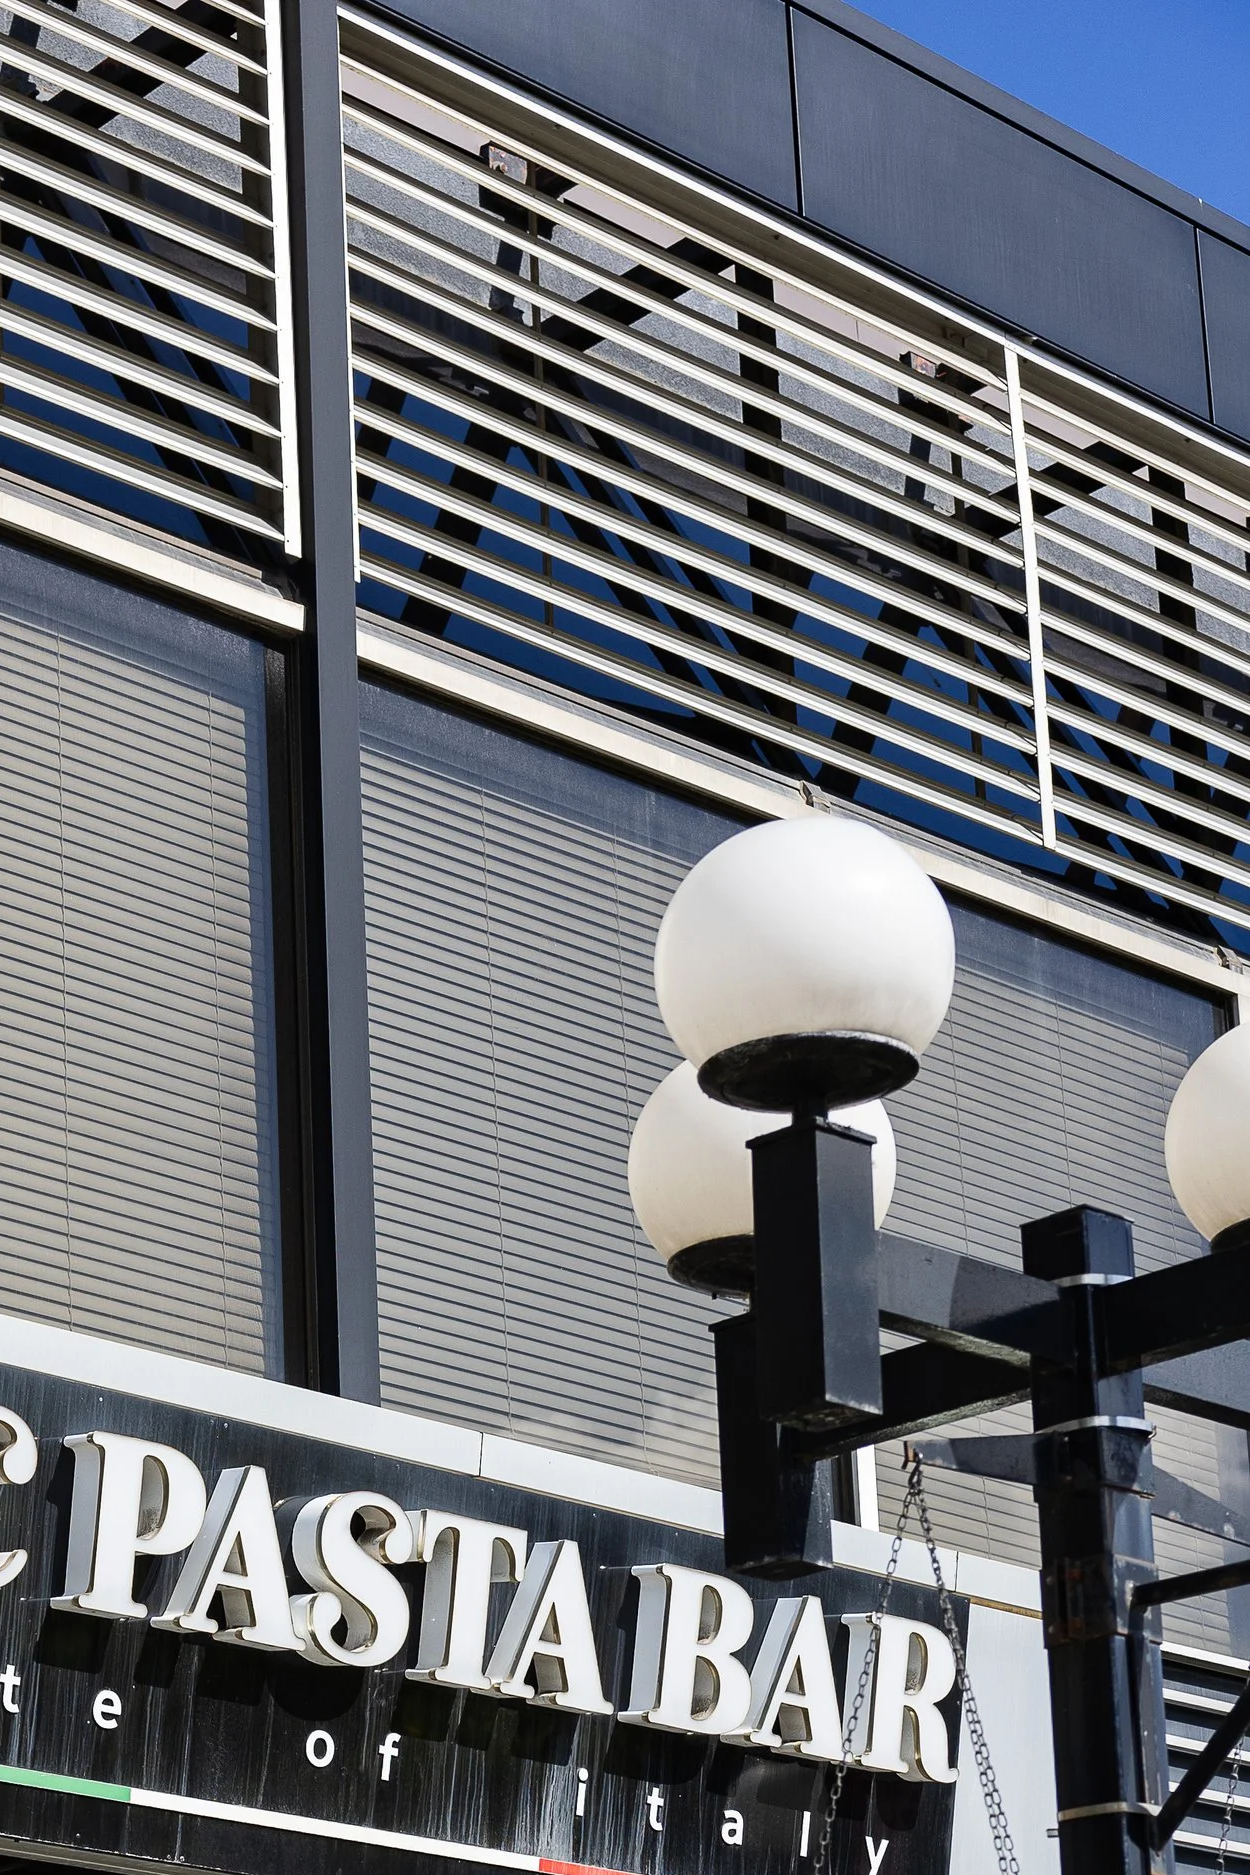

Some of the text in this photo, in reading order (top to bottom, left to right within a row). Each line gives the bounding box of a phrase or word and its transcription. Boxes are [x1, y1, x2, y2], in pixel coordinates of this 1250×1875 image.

[51, 1430, 613, 1716] PASTA
[618, 1562, 959, 1783] BAR
[306, 1731, 401, 1782] of
